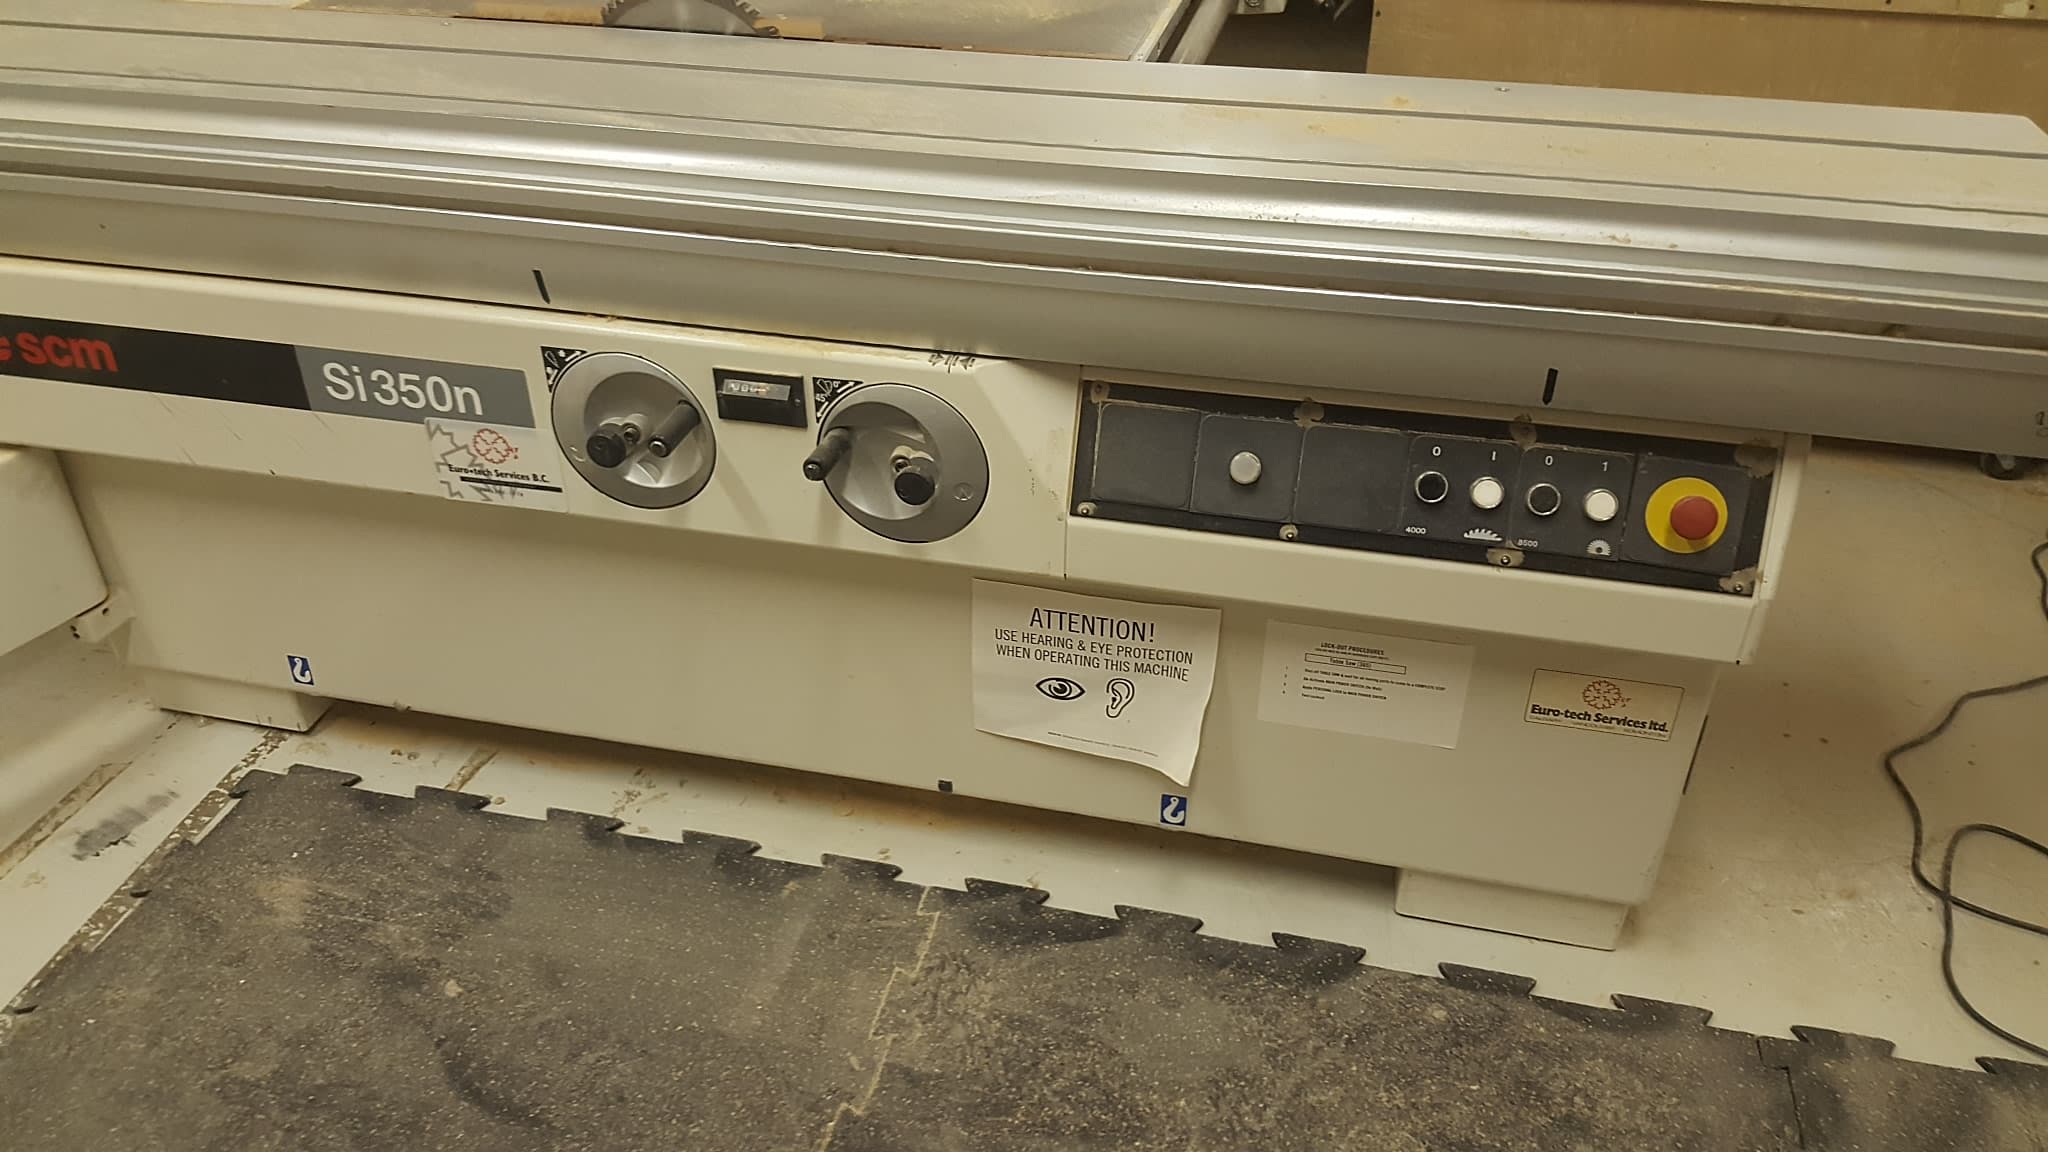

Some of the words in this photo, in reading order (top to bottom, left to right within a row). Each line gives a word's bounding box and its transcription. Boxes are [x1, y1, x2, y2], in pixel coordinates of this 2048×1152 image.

[16, 331, 118, 372] scm
[494, 468, 531, 482] Services
[1405, 526, 1427, 535] 4000
[1029, 607, 1156, 643] ATTENTION!
[994, 628, 1018, 642] USE
[1021, 632, 1074, 650] HEARING
[1077, 639, 1087, 651] &
[1090, 642, 1113, 656] EYE
[1116, 645, 1193, 665] PROTECTION
[996, 643, 1032, 660] WHEN
[1034, 648, 1100, 669] OPERATING
[1103, 658, 1131, 673] THIS
[1133, 661, 1190, 682] MACHINE
[1530, 704, 1592, 721] Euro-tech
[1592, 712, 1648, 729] Services
[1648, 719, 1668, 733] ltd.
